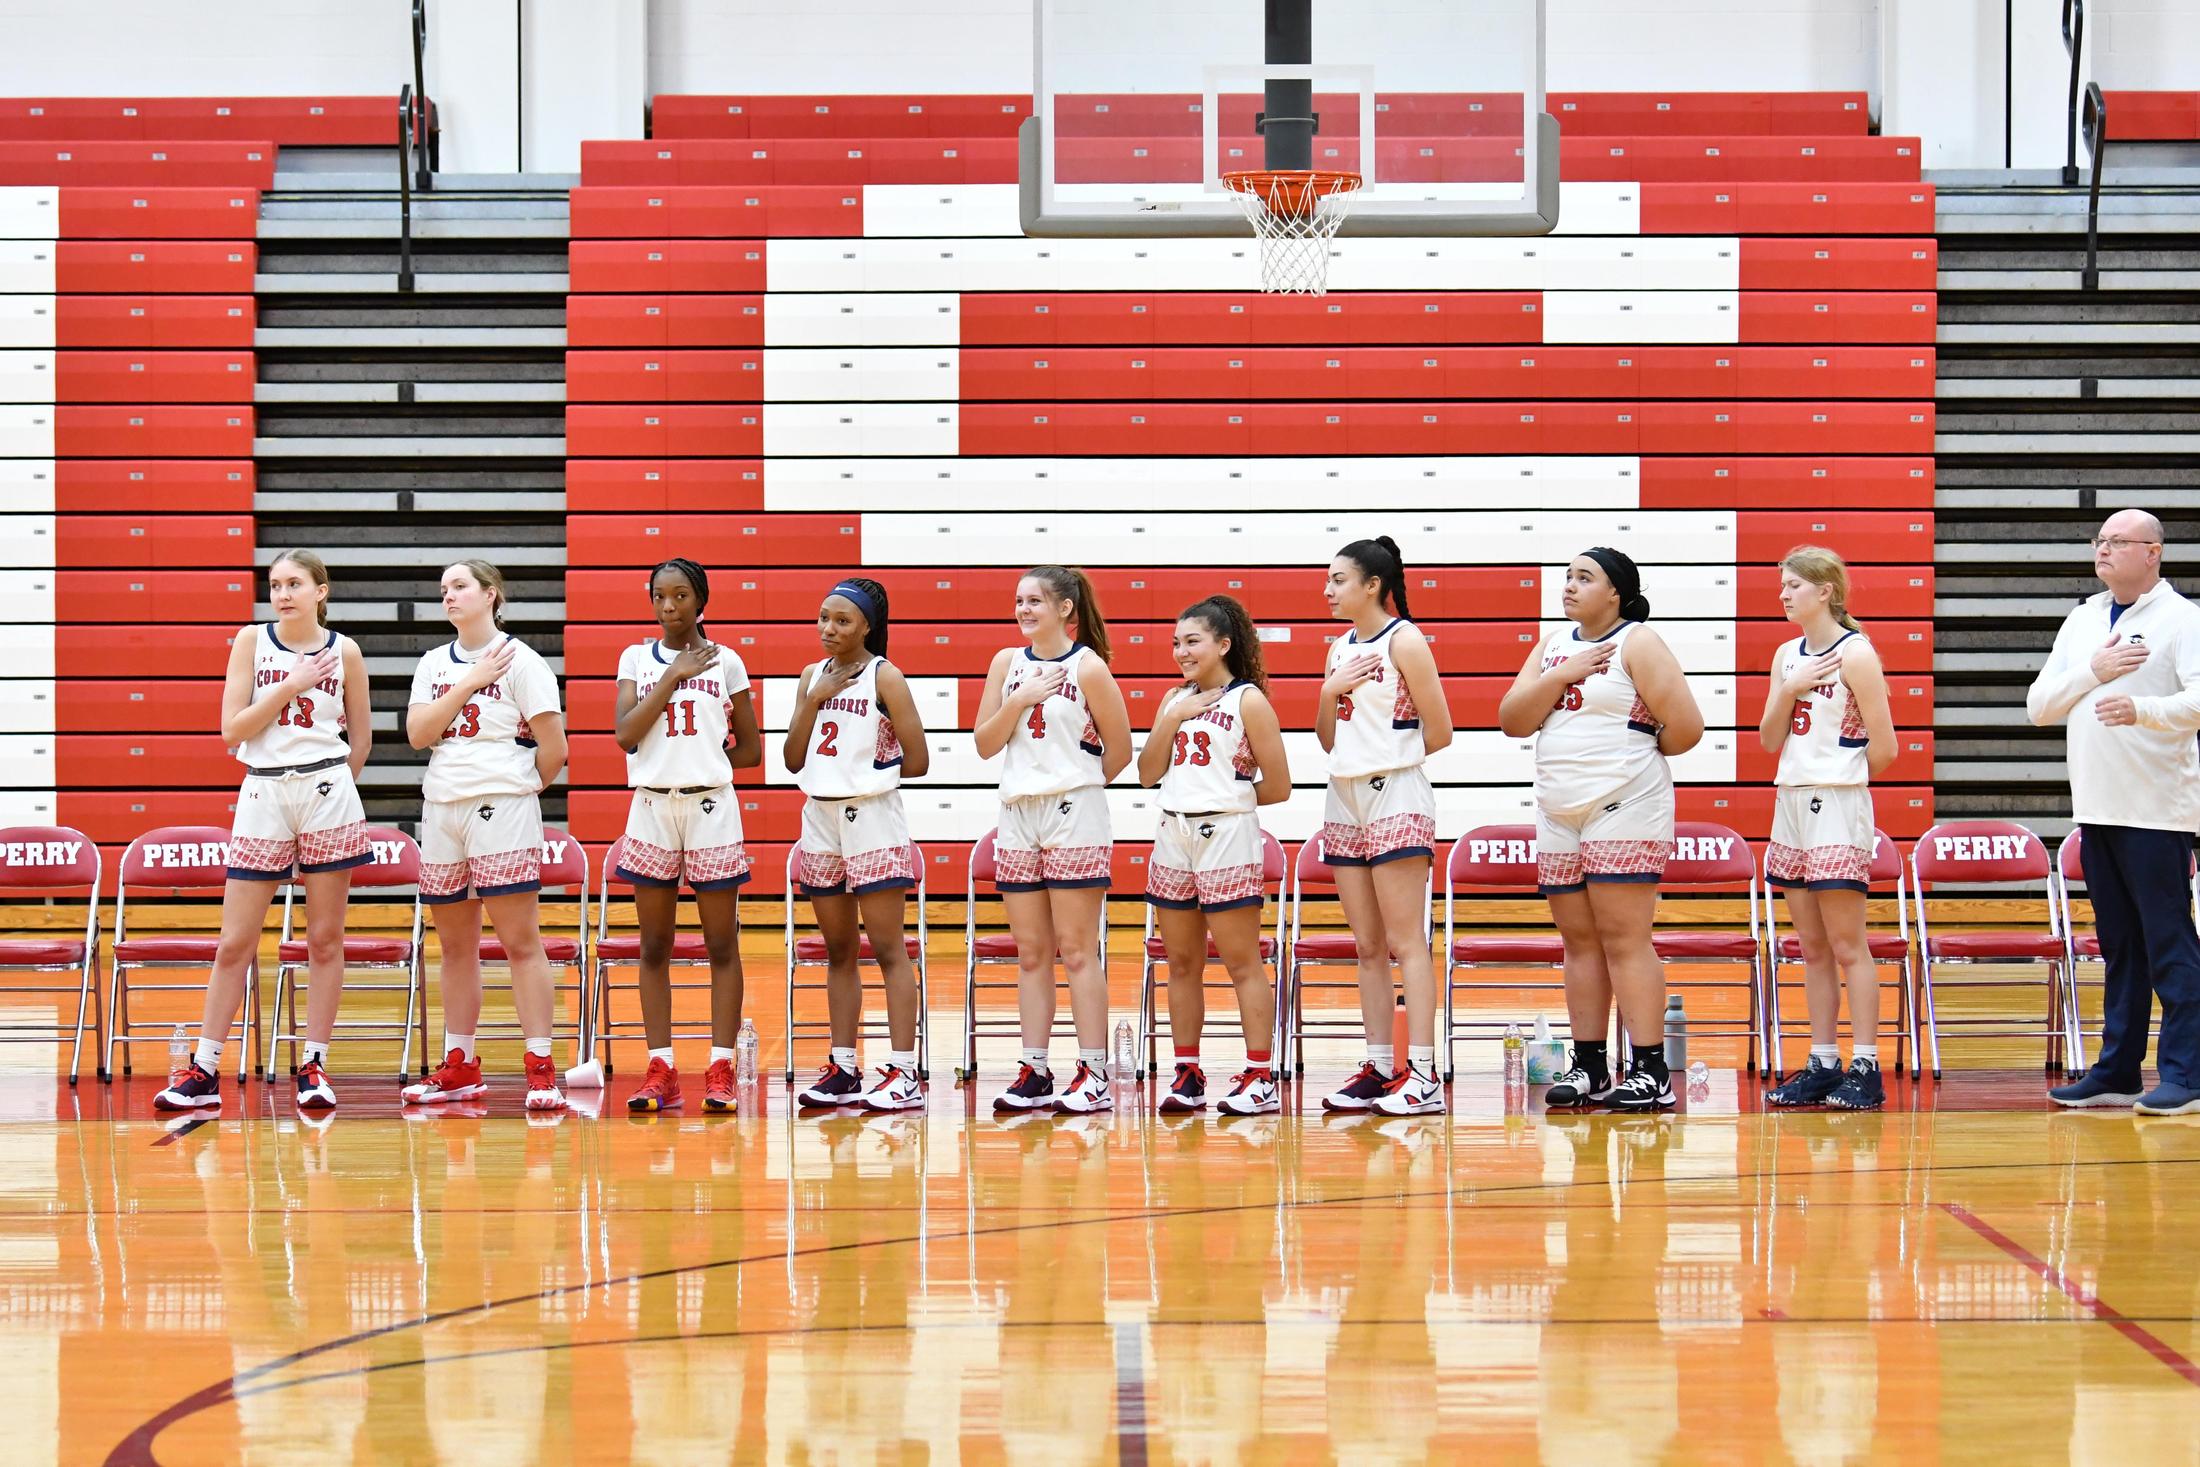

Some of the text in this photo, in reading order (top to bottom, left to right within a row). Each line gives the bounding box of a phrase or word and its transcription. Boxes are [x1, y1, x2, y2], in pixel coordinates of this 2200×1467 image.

[278, 695, 315, 728] 13
[664, 700, 697, 737] 11
[1027, 702, 1046, 739] 4
[1792, 699, 1812, 736] 5
[816, 721, 838, 757] 2
[1174, 731, 1212, 766] 33
[1470, 839, 1537, 864] PER
[1669, 837, 1734, 861] RRY
[1934, 835, 2029, 861] PERRY
